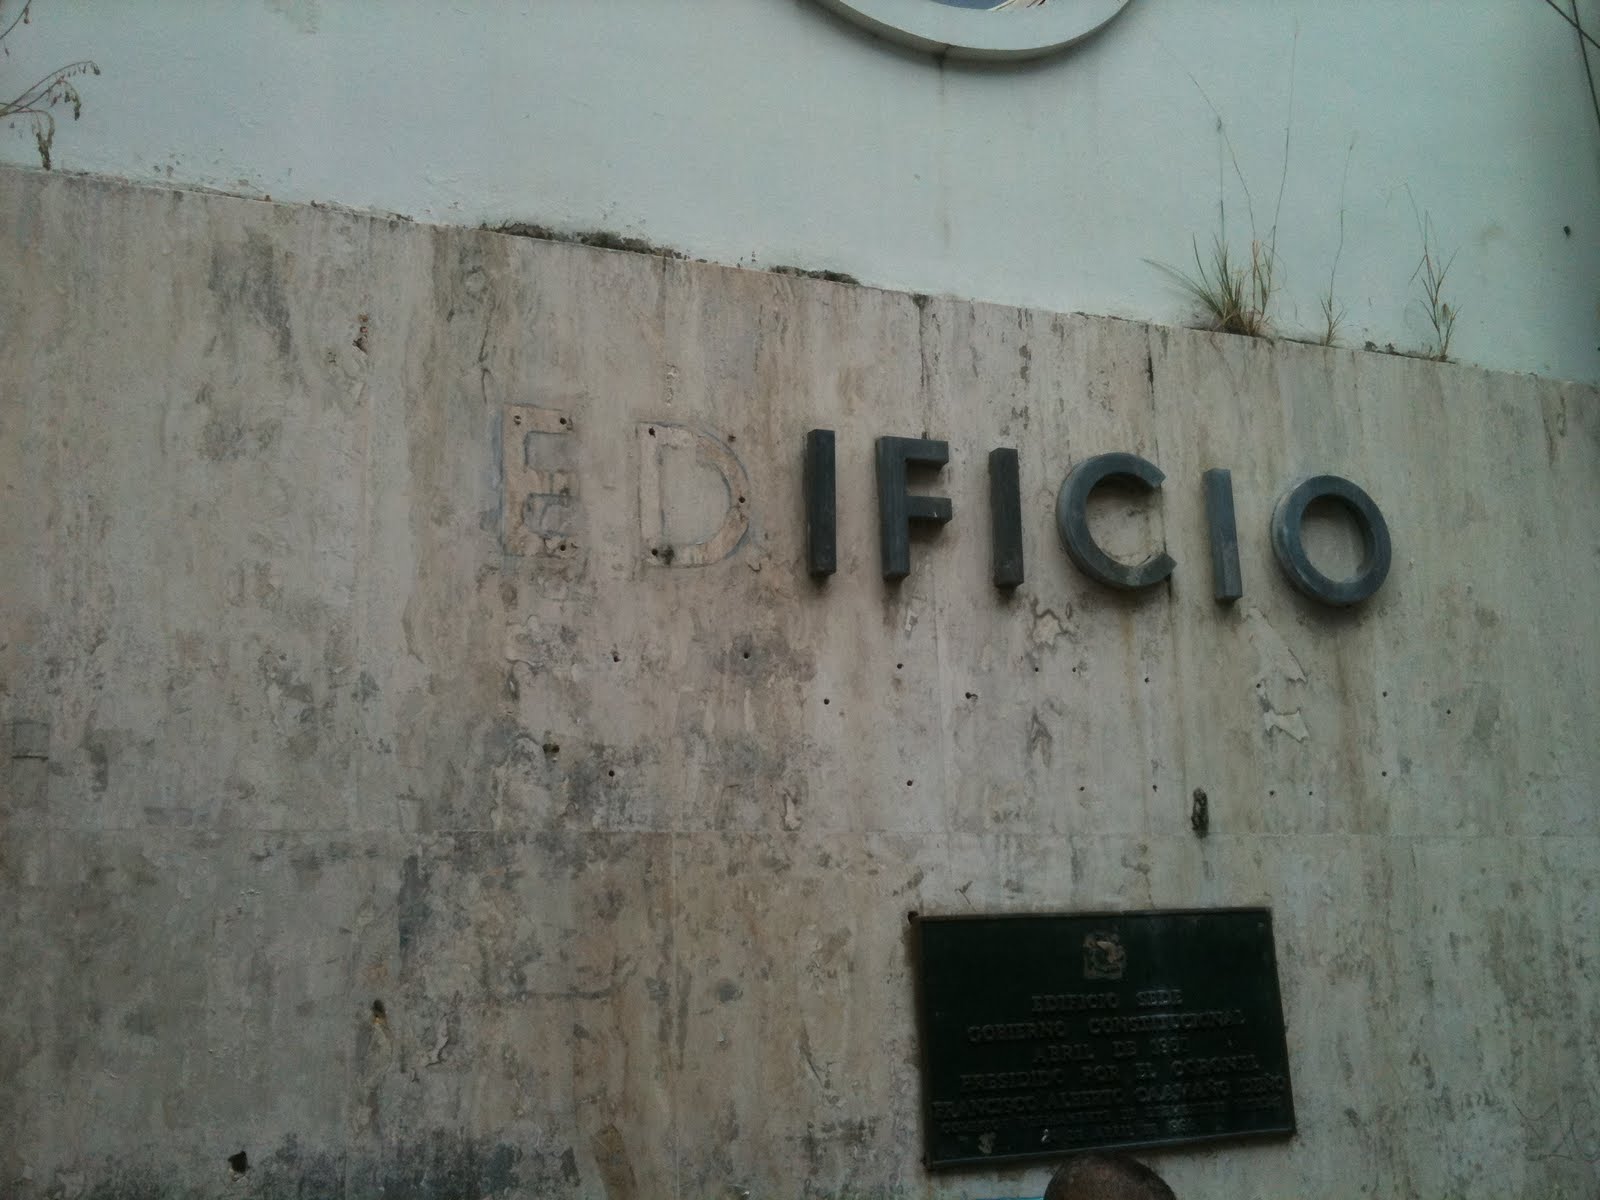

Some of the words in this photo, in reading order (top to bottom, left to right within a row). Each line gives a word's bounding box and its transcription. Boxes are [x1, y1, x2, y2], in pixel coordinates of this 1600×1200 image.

[500, 403, 1392, 607] EDIFICIO
[1032, 991, 1120, 1012] EDIFICIO
[1137, 988, 1184, 1007] SEDE
[967, 1019, 1068, 1042] GOBIERNO
[1088, 1009, 1246, 1035] CONSTITUCIONAL
[1032, 1043, 1095, 1063] ABRIL
[959, 1068, 1067, 1091] PRESIDIDO
[1081, 1065, 1120, 1085] POR
[932, 1096, 1038, 1119] FRANCISCO
